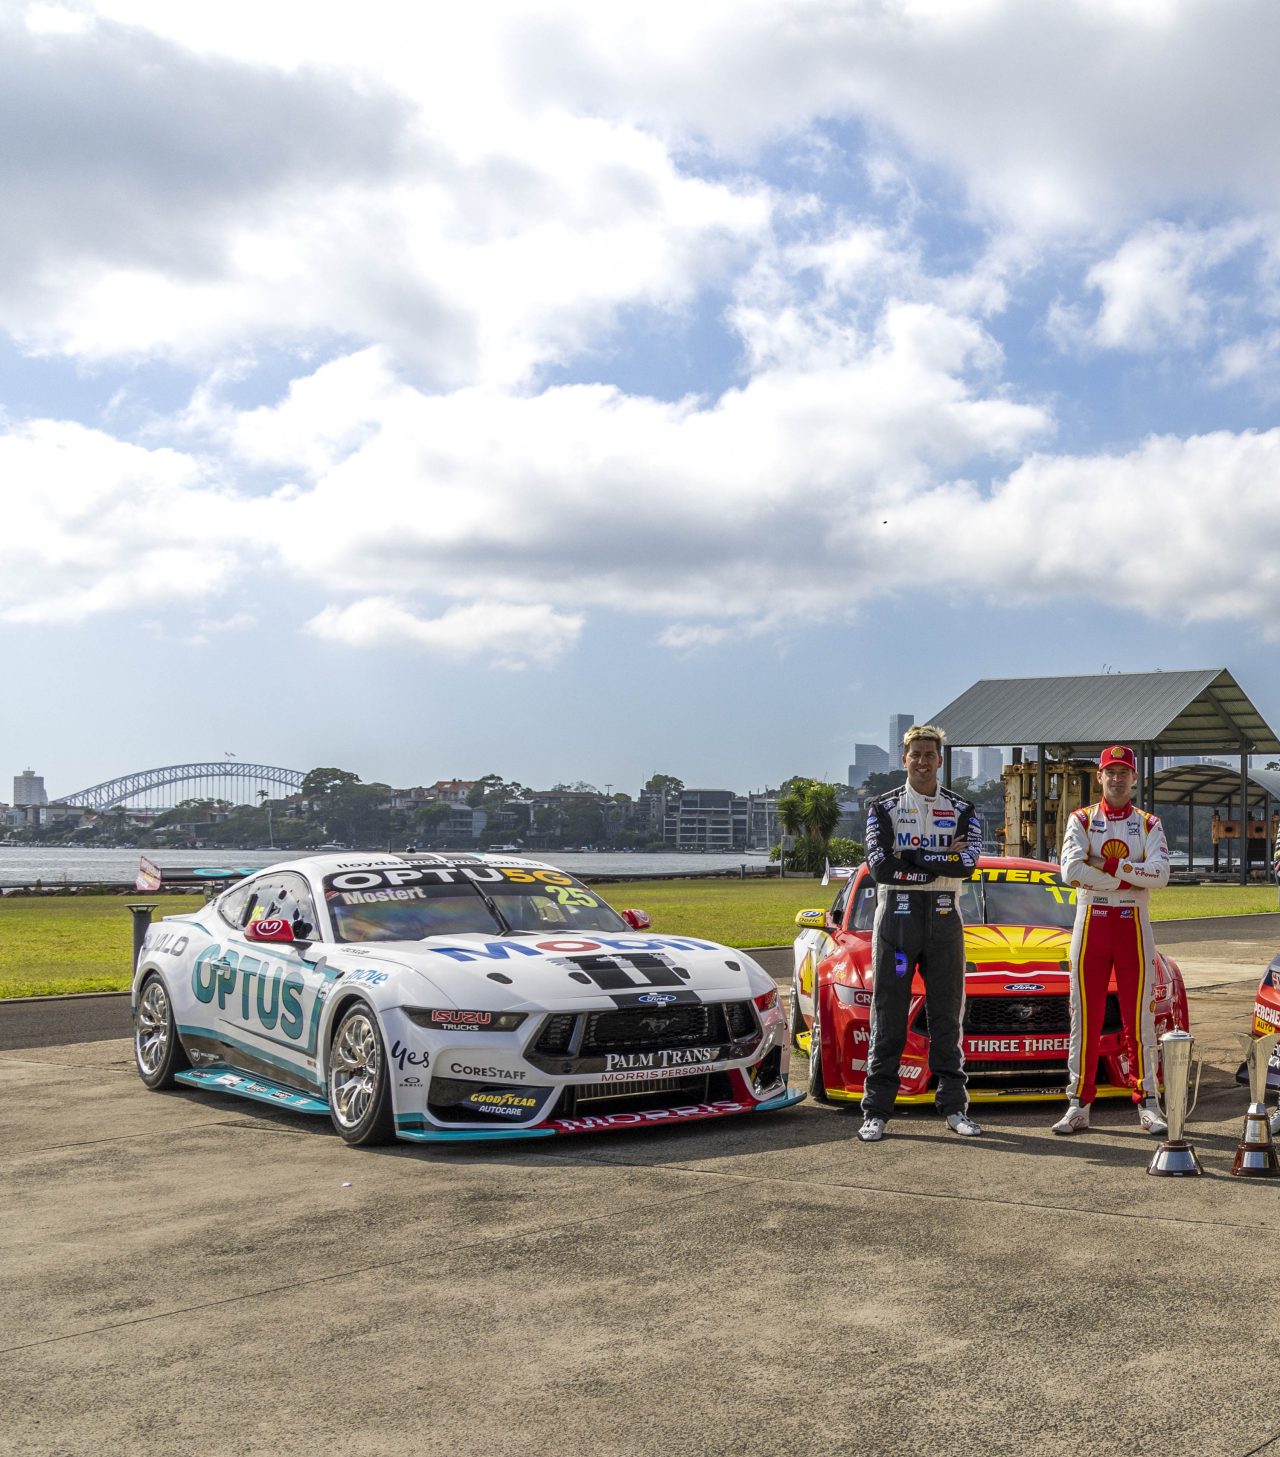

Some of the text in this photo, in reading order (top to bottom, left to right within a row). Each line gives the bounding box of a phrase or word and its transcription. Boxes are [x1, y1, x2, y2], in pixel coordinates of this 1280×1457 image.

[897, 833, 937, 848] Mobil
[336, 859, 545, 869] lloydsauctions.com.au
[893, 871, 918, 881] Mobil
[1134, 870, 1159, 878] V-Power
[343, 887, 428, 906] Mostert
[544, 885, 599, 908] 25
[1045, 886, 1077, 905] 17
[427, 936, 720, 963] Mobil
[348, 968, 389, 986] move
[191, 943, 304, 1041] OPTUS
[431, 1009, 492, 1025] ISUZU
[442, 1023, 480, 1032] TRUCKS
[1256, 1021, 1273, 1033] AUTO
[968, 1039, 1020, 1052] THREE
[391, 1040, 431, 1071] yes
[604, 1048, 712, 1071] PALM TRANS
[601, 1064, 718, 1082] MORRIS PERSONAL
[470, 1093, 537, 1107] GOODYEAR
[478, 1105, 522, 1116] AUTOCARE
[553, 1100, 744, 1131] MORRIS
